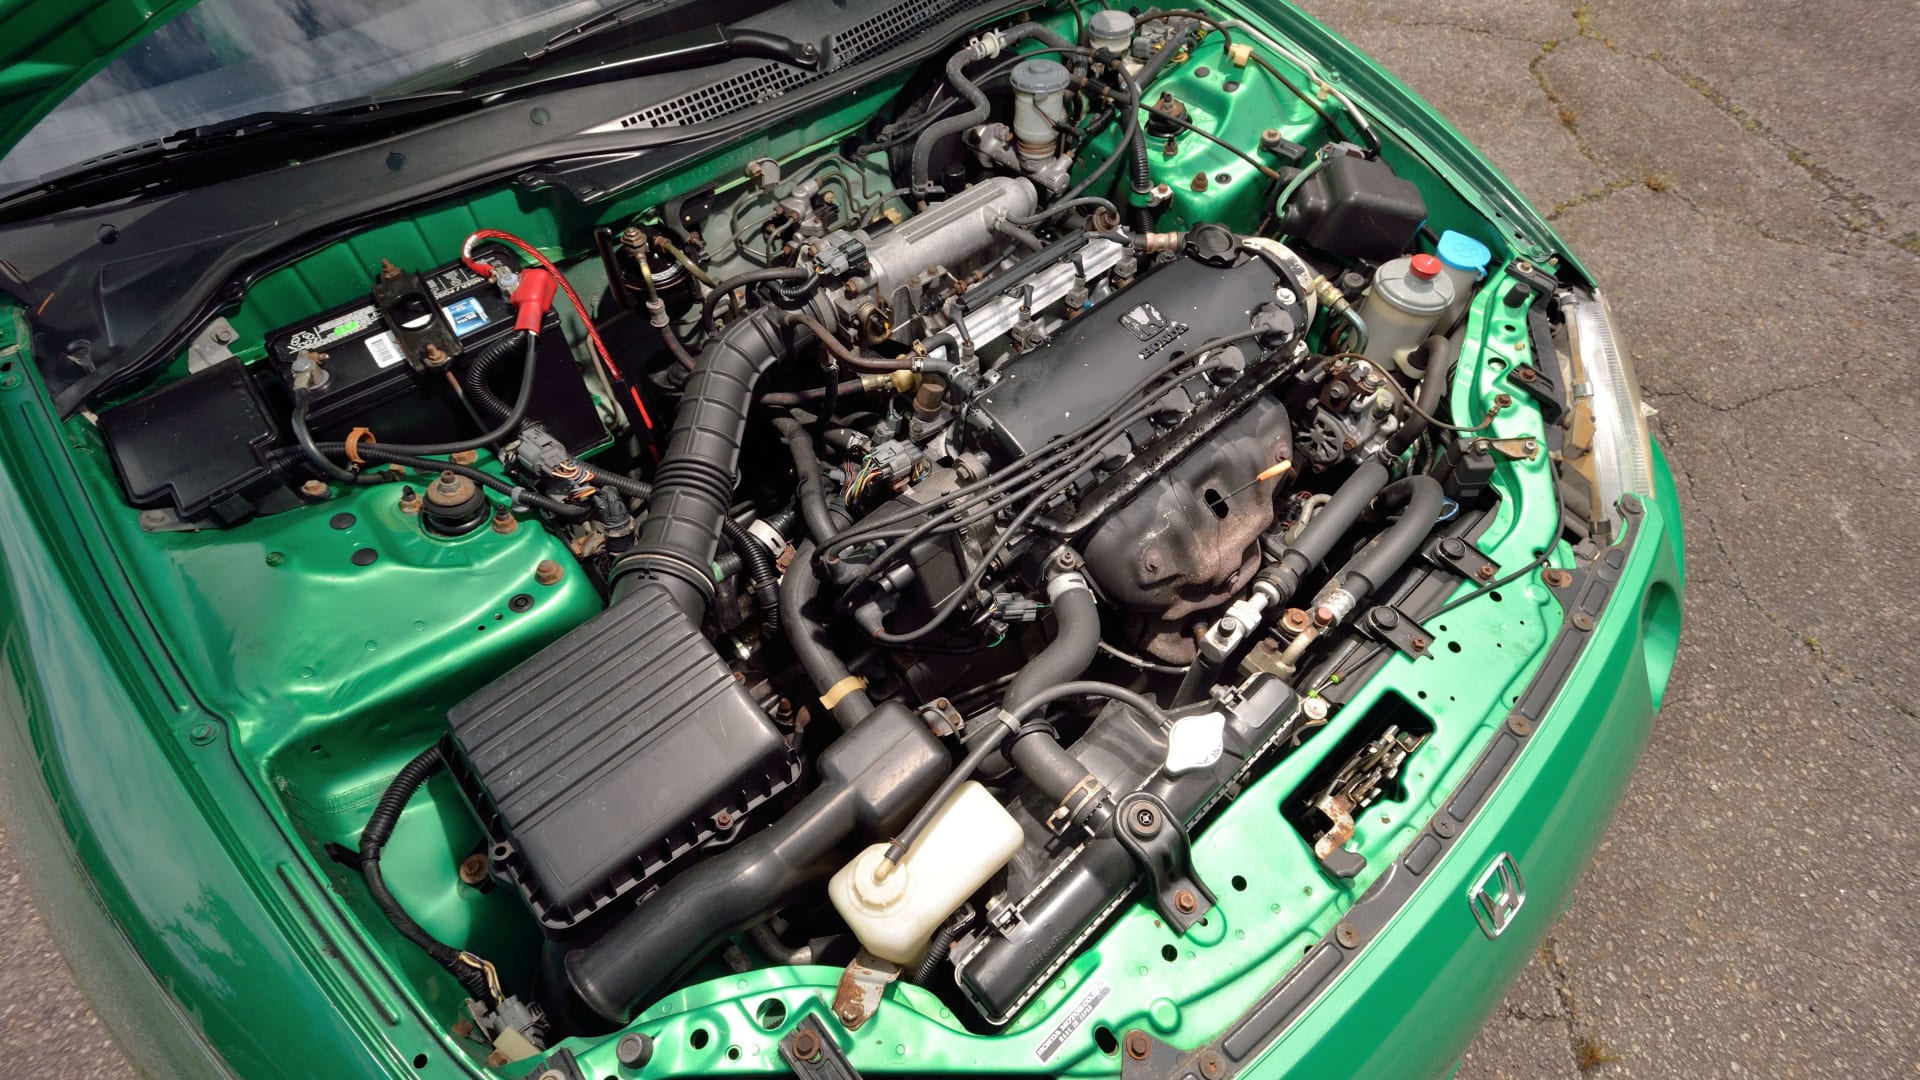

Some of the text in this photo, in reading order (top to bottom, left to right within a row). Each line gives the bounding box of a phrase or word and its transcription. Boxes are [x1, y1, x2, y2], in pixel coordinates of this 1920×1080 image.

[1139, 323, 1189, 359] HONDA
[1036, 1029, 1061, 1055] HONDA
[1059, 1004, 1084, 1031] MOTOR
[1057, 1026, 1072, 1042] MADE
[1077, 1004, 1093, 1020] JAPAN
